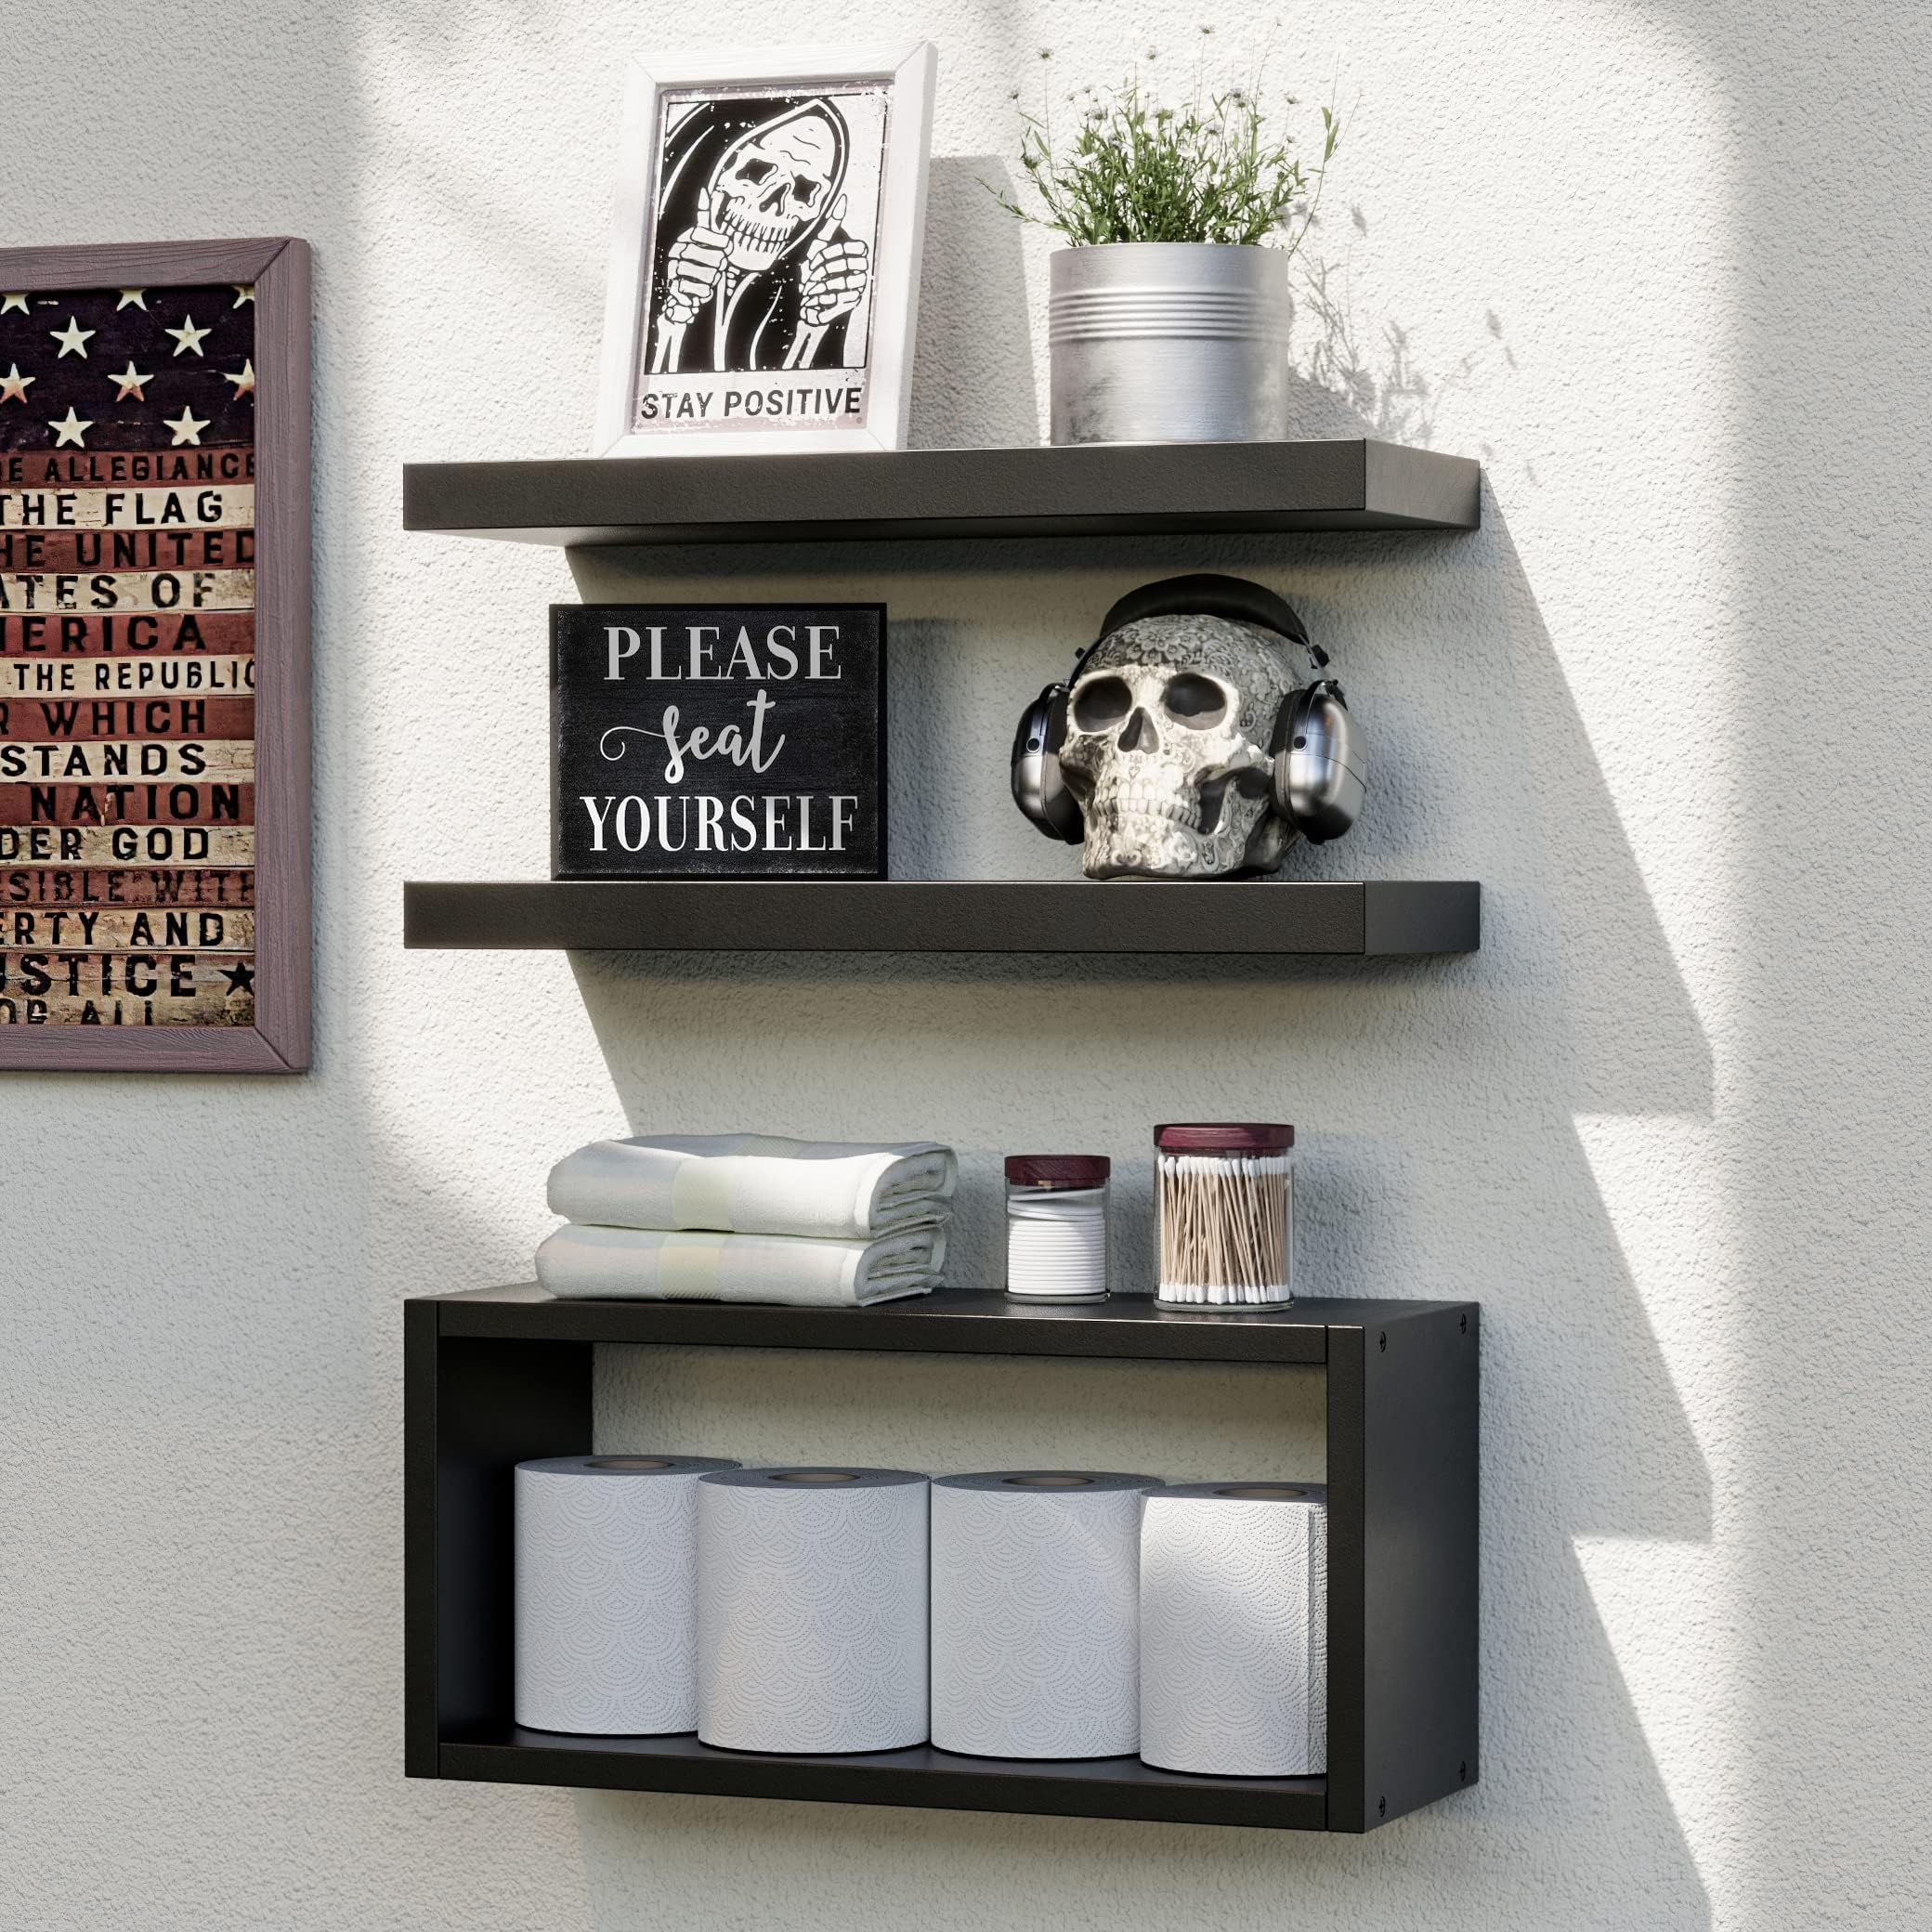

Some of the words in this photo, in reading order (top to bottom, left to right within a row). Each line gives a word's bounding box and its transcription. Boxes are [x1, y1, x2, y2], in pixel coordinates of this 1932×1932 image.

[641, 391, 713, 419] STAY
[724, 387, 862, 417] POSITIVE
[103, 490, 223, 527] FLAG
[75, 529, 255, 568] UNITED
[150, 572, 215, 608] OF
[0, 614, 206, 652] ERICA
[603, 625, 842, 681] PLEASE
[14, 663, 75, 691] THE
[40, 699, 205, 736] WHICH
[599, 688, 786, 785] seat
[1, 743, 206, 777] STANDS
[30, 784, 240, 821] NATION
[579, 795, 859, 853] YOURSELF
[0, 828, 83, 860] DER
[111, 827, 209, 861] GOD
[0, 911, 99, 946] RTY
[129, 911, 224, 946] AND
[0, 954, 196, 998] STICE
